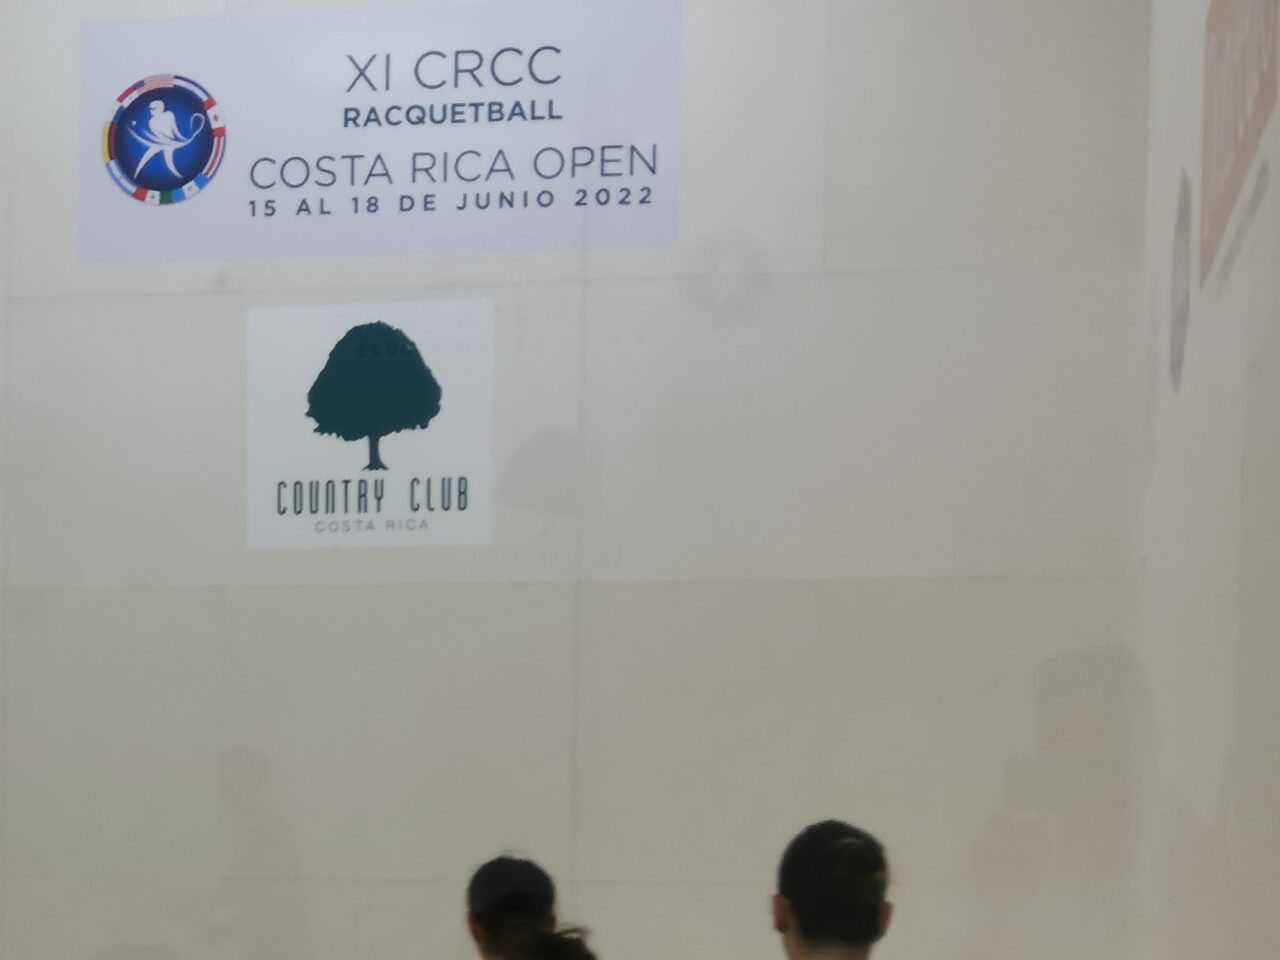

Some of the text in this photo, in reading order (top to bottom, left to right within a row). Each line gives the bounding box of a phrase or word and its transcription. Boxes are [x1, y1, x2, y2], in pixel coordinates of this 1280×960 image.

[345, 46, 562, 92] XI CRCC
[343, 99, 563, 128] RACQUETBALL
[249, 144, 658, 189] COSTA RICA OPEN
[249, 186, 653, 217] 15 AL 18 DE JUNIO 2022
[277, 476, 468, 515] COUNTRY CLUB
[314, 518, 429, 533] COSTA RICA
